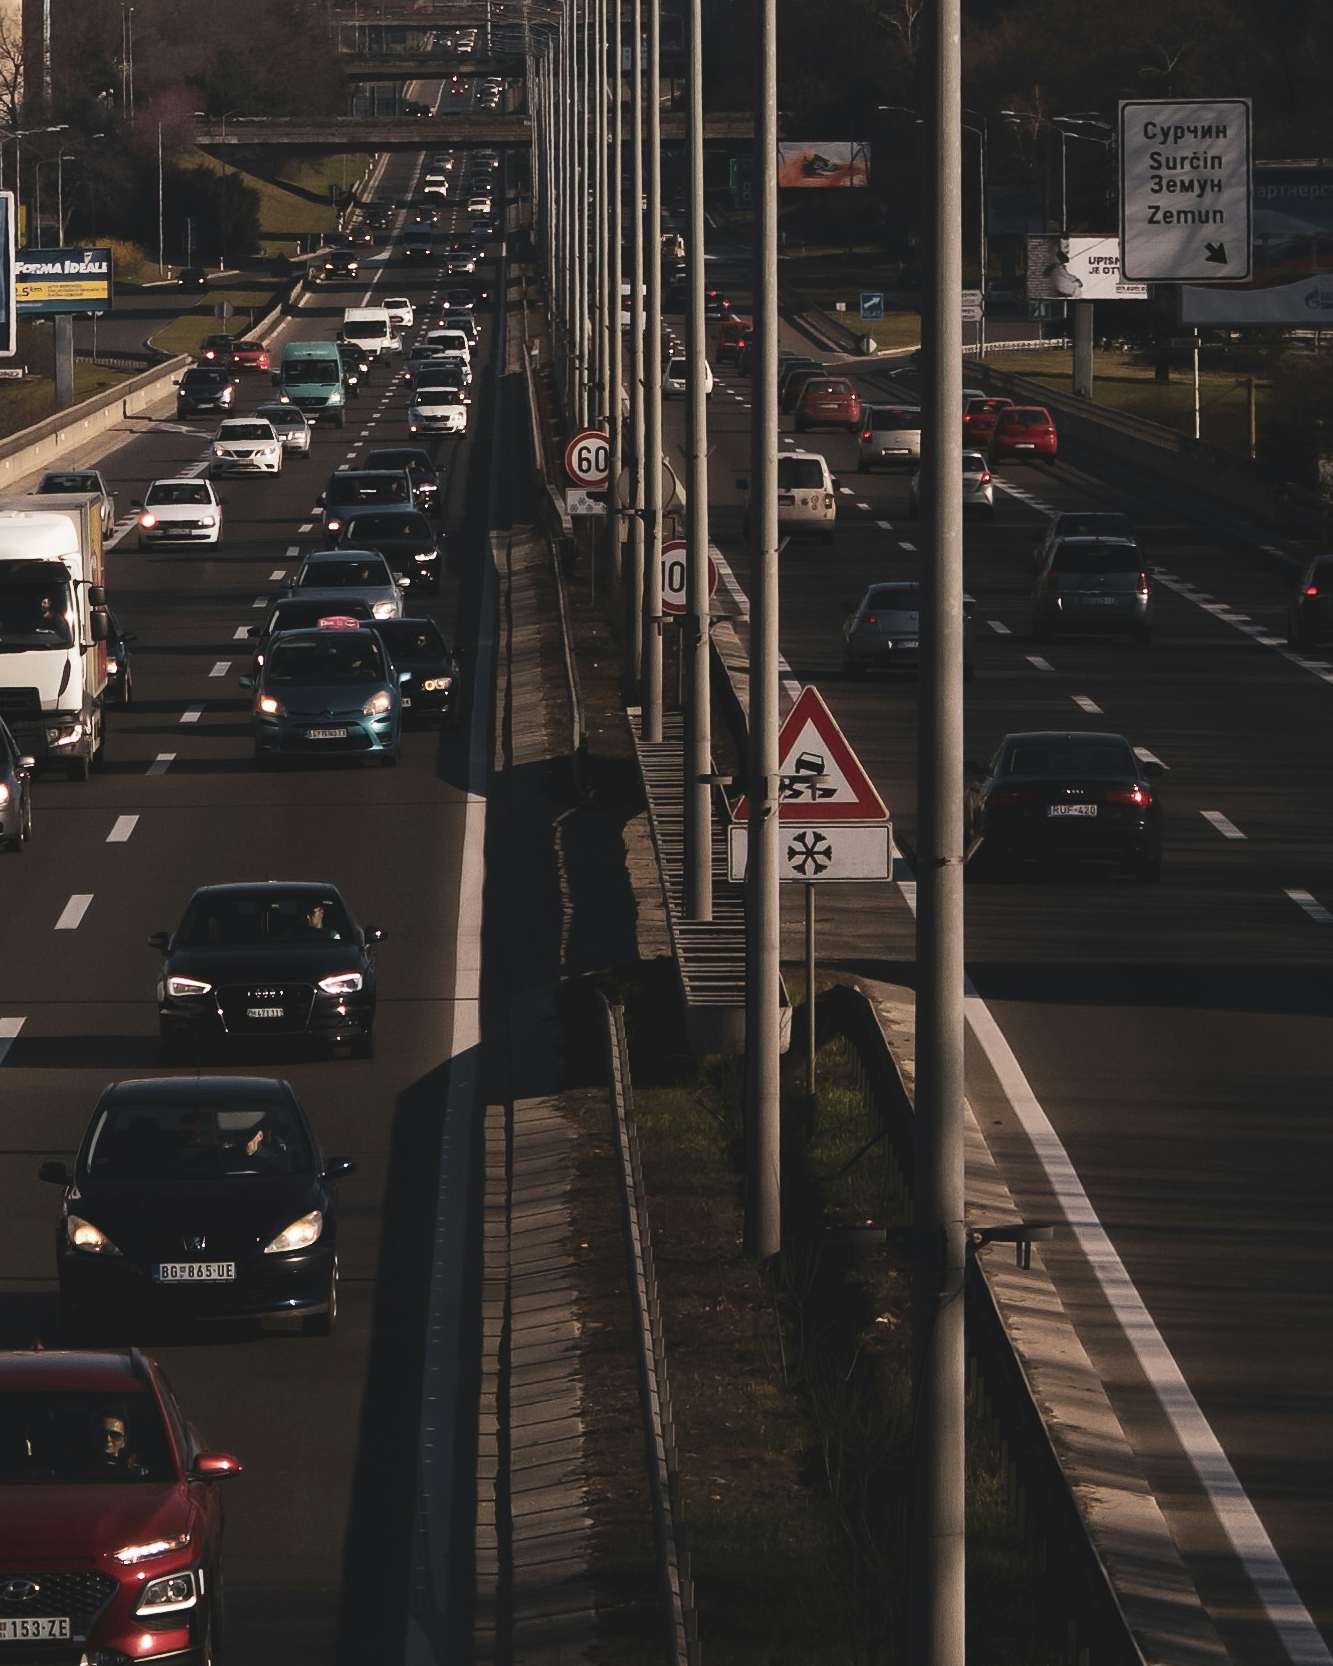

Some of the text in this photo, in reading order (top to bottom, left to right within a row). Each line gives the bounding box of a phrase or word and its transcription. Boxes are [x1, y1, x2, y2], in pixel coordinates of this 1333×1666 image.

[1143, 121, 1228, 145] Сурчин
[1149, 151, 1223, 171] Surčin
[1149, 175, 1223, 198] Земун
[1252, 184, 1333, 201] артнерс
[1147, 204, 1224, 225] Zemun
[577, 445, 609, 474] 60
[161, 1265, 178, 1279] BG
